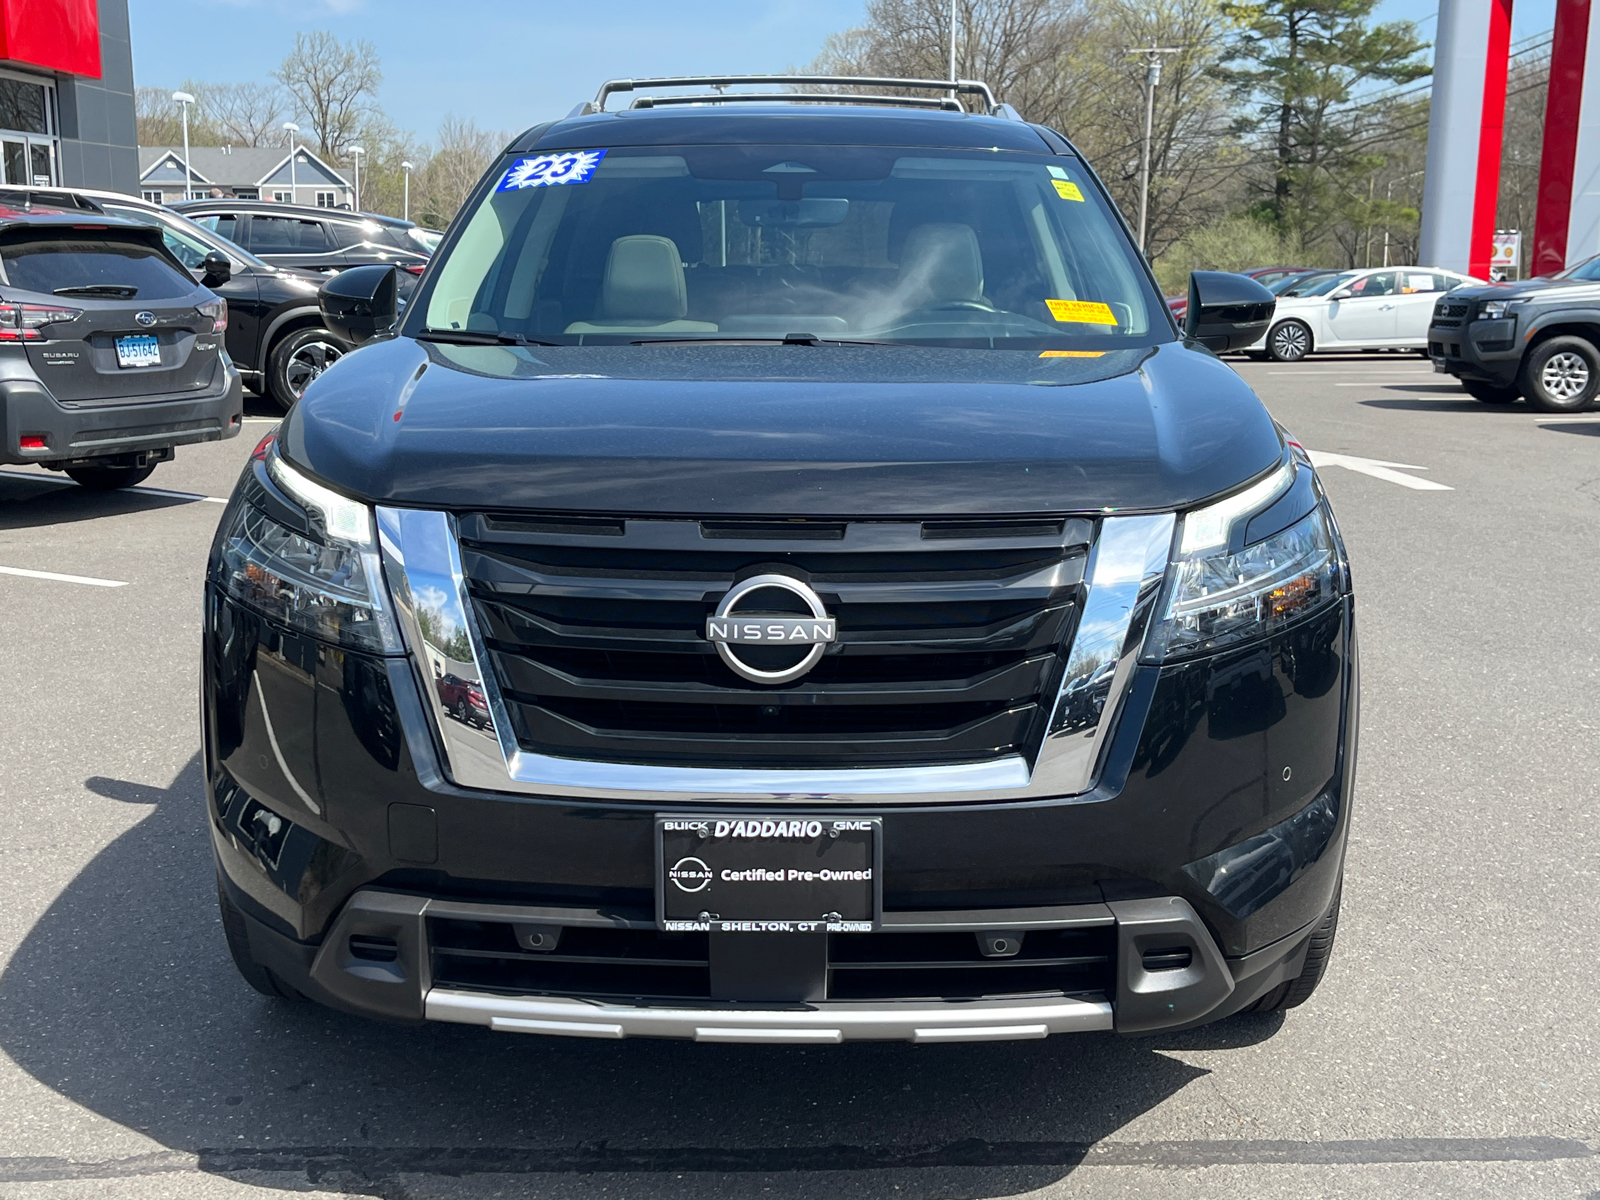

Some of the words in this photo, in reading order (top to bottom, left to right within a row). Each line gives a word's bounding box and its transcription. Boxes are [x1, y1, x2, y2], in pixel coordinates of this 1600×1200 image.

[523, 158, 578, 181] 23
[1070, 302, 1106, 310] VEHICLE
[709, 622, 832, 640] NISSAN
[664, 821, 708, 830] BUICK
[714, 820, 823, 838] D'ADDARIO
[833, 821, 872, 830] GMC
[669, 870, 713, 878] NISSAN
[721, 868, 785, 881] Certified
[787, 868, 872, 881] Pre-Owned
[665, 922, 710, 931] NISSAN
[721, 922, 794, 932] SHELTON,
[797, 922, 818, 931] CT
[826, 923, 872, 931] PRE-OWNED
